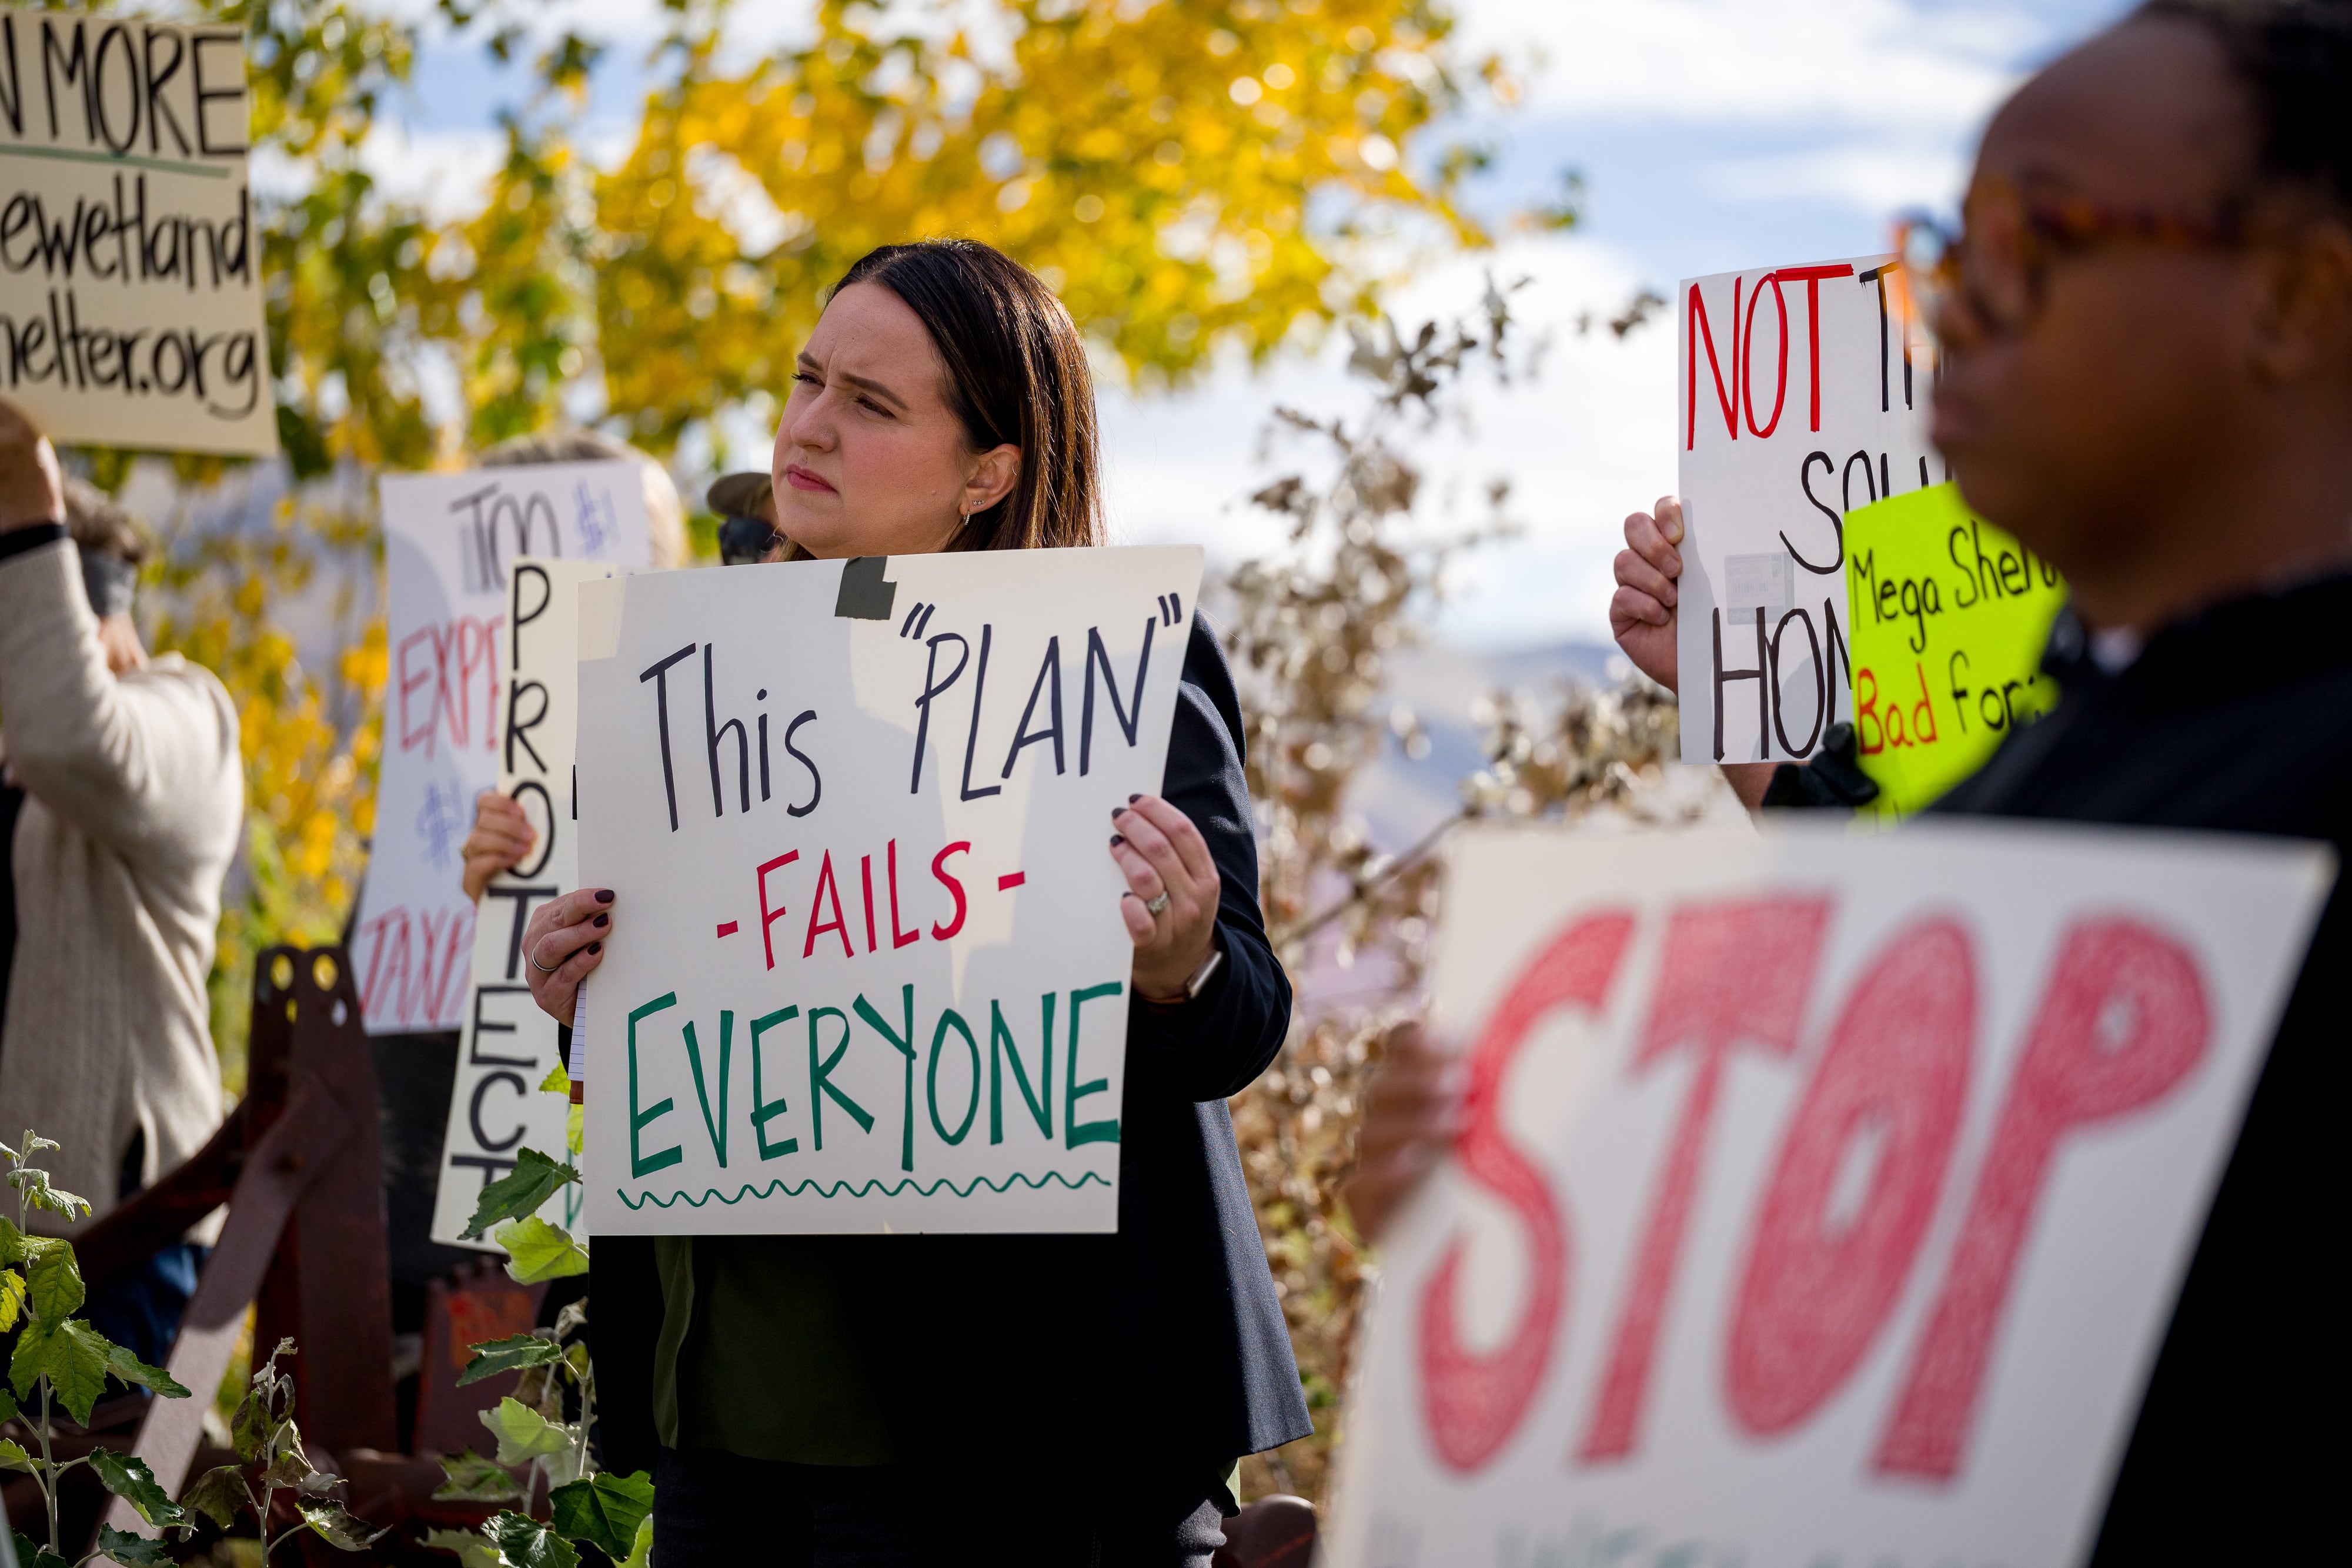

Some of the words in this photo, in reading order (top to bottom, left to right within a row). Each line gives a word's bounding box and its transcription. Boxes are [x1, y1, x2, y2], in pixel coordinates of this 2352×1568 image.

[41, 19, 246, 156] MORE
[1686, 263, 1853, 451] NOT
[1852, 548, 1943, 655] Mega
[640, 643, 822, 832] This
[900, 593, 1181, 802] "PLAN"
[1857, 661, 1938, 756] Bad
[628, 981, 1123, 1180] EVERYONE
[1414, 887, 2214, 1493] STOP
